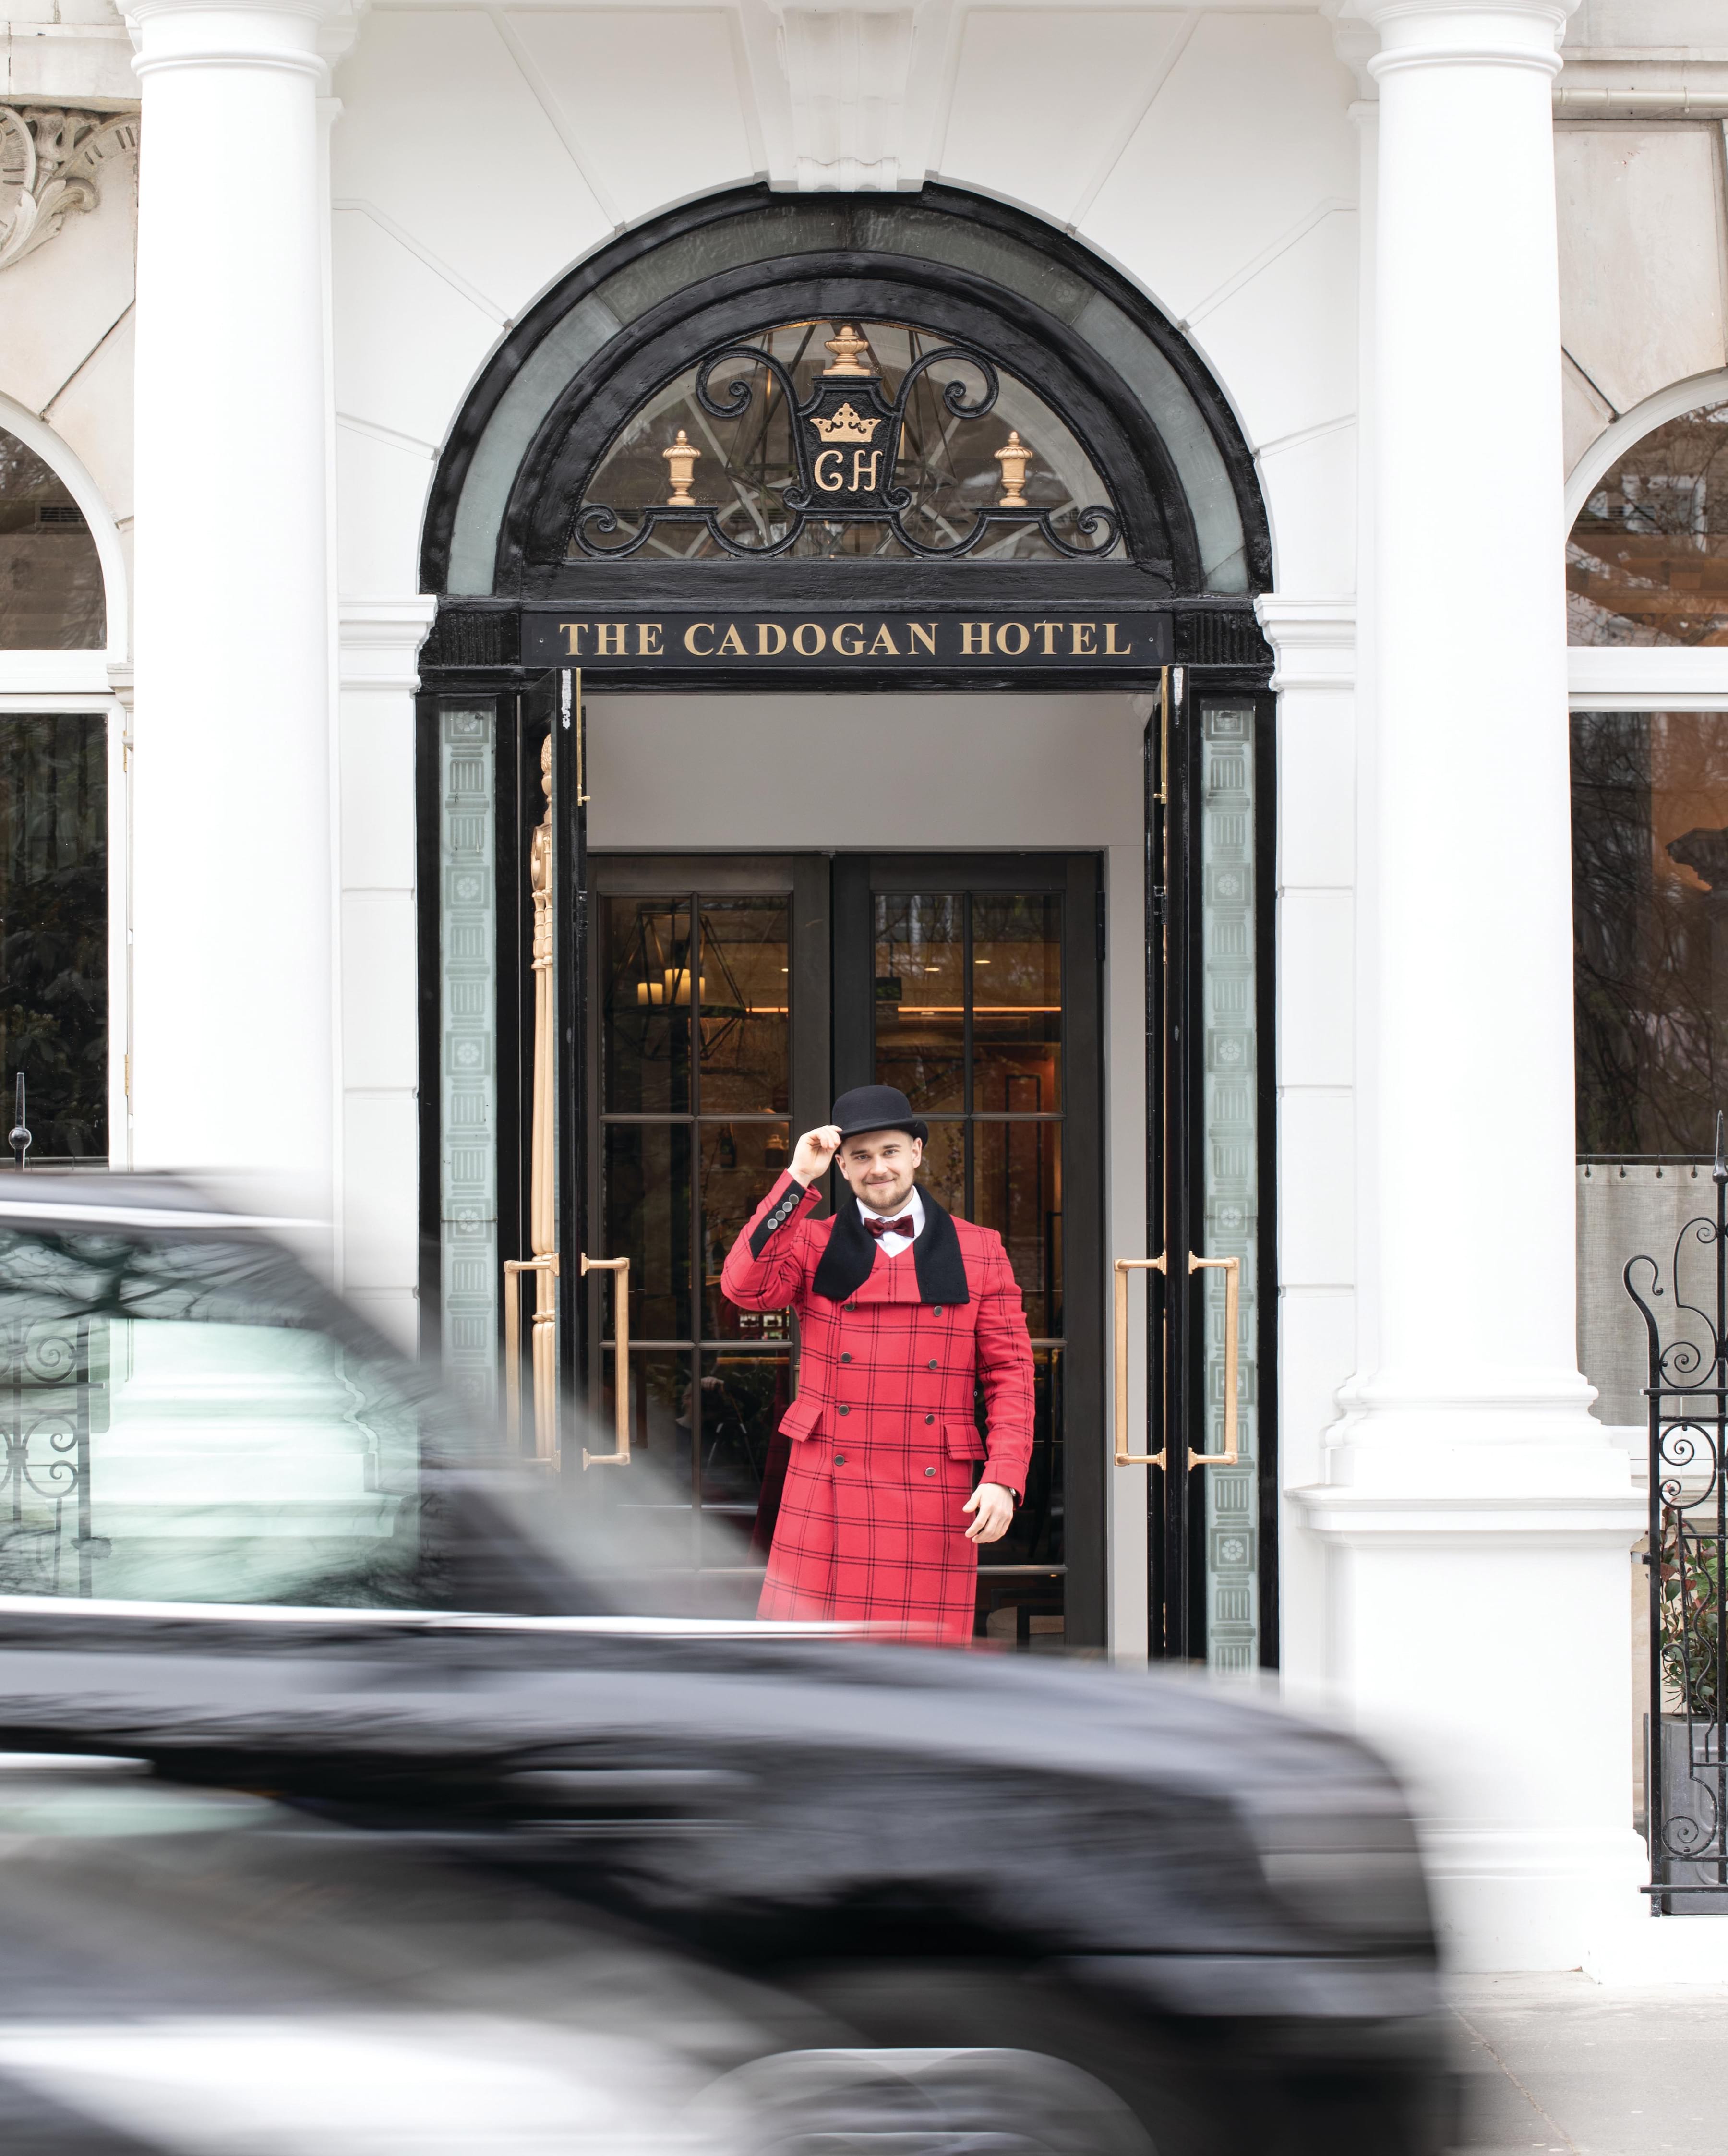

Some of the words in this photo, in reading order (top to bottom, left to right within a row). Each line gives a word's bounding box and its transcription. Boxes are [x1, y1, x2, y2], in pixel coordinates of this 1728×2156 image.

[559, 623, 664, 655] THE
[684, 623, 938, 656] CADOGAN
[960, 623, 1131, 655] HOTEL
